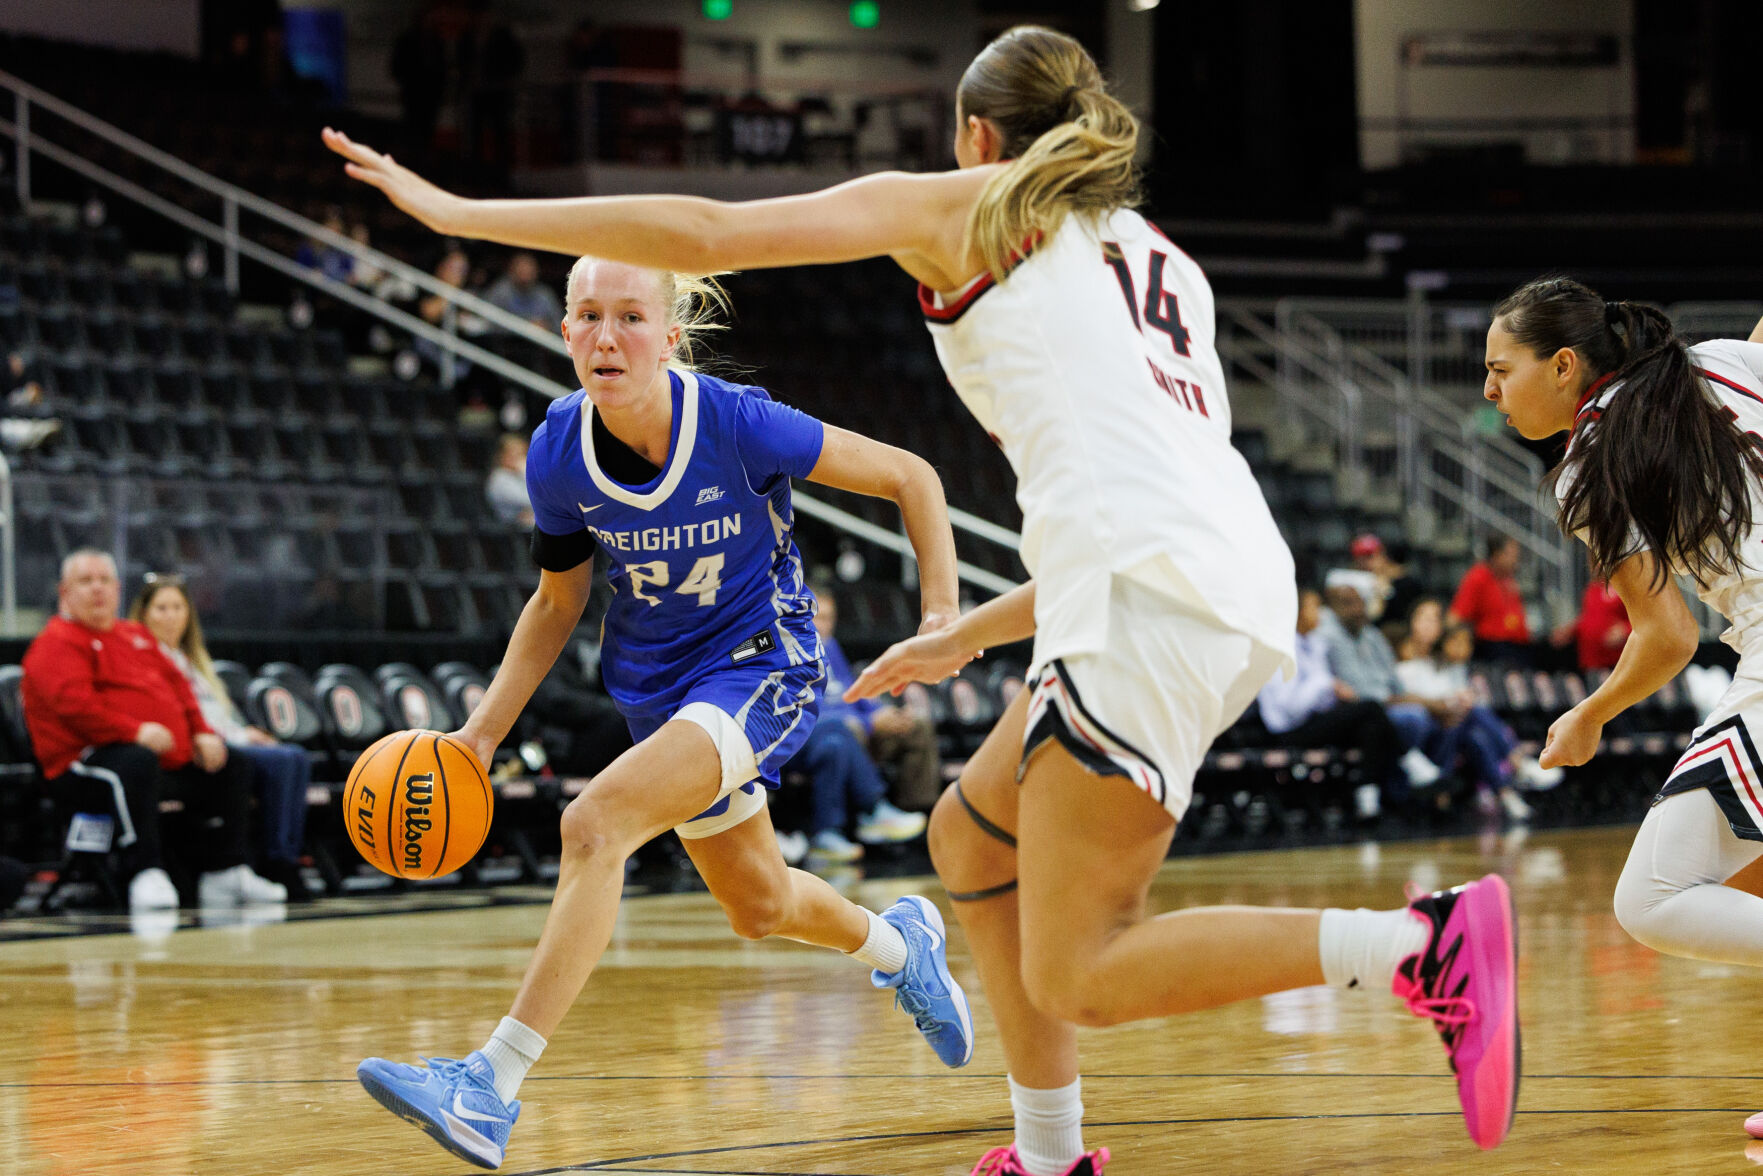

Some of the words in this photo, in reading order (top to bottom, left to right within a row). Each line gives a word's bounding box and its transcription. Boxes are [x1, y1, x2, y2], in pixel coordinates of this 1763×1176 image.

[1101, 240, 1191, 358] 14
[696, 490, 726, 503] EAST
[698, 485, 719, 495] BIG
[625, 552, 725, 607] 24
[758, 636, 769, 648] M
[405, 771, 435, 869] Wilson
